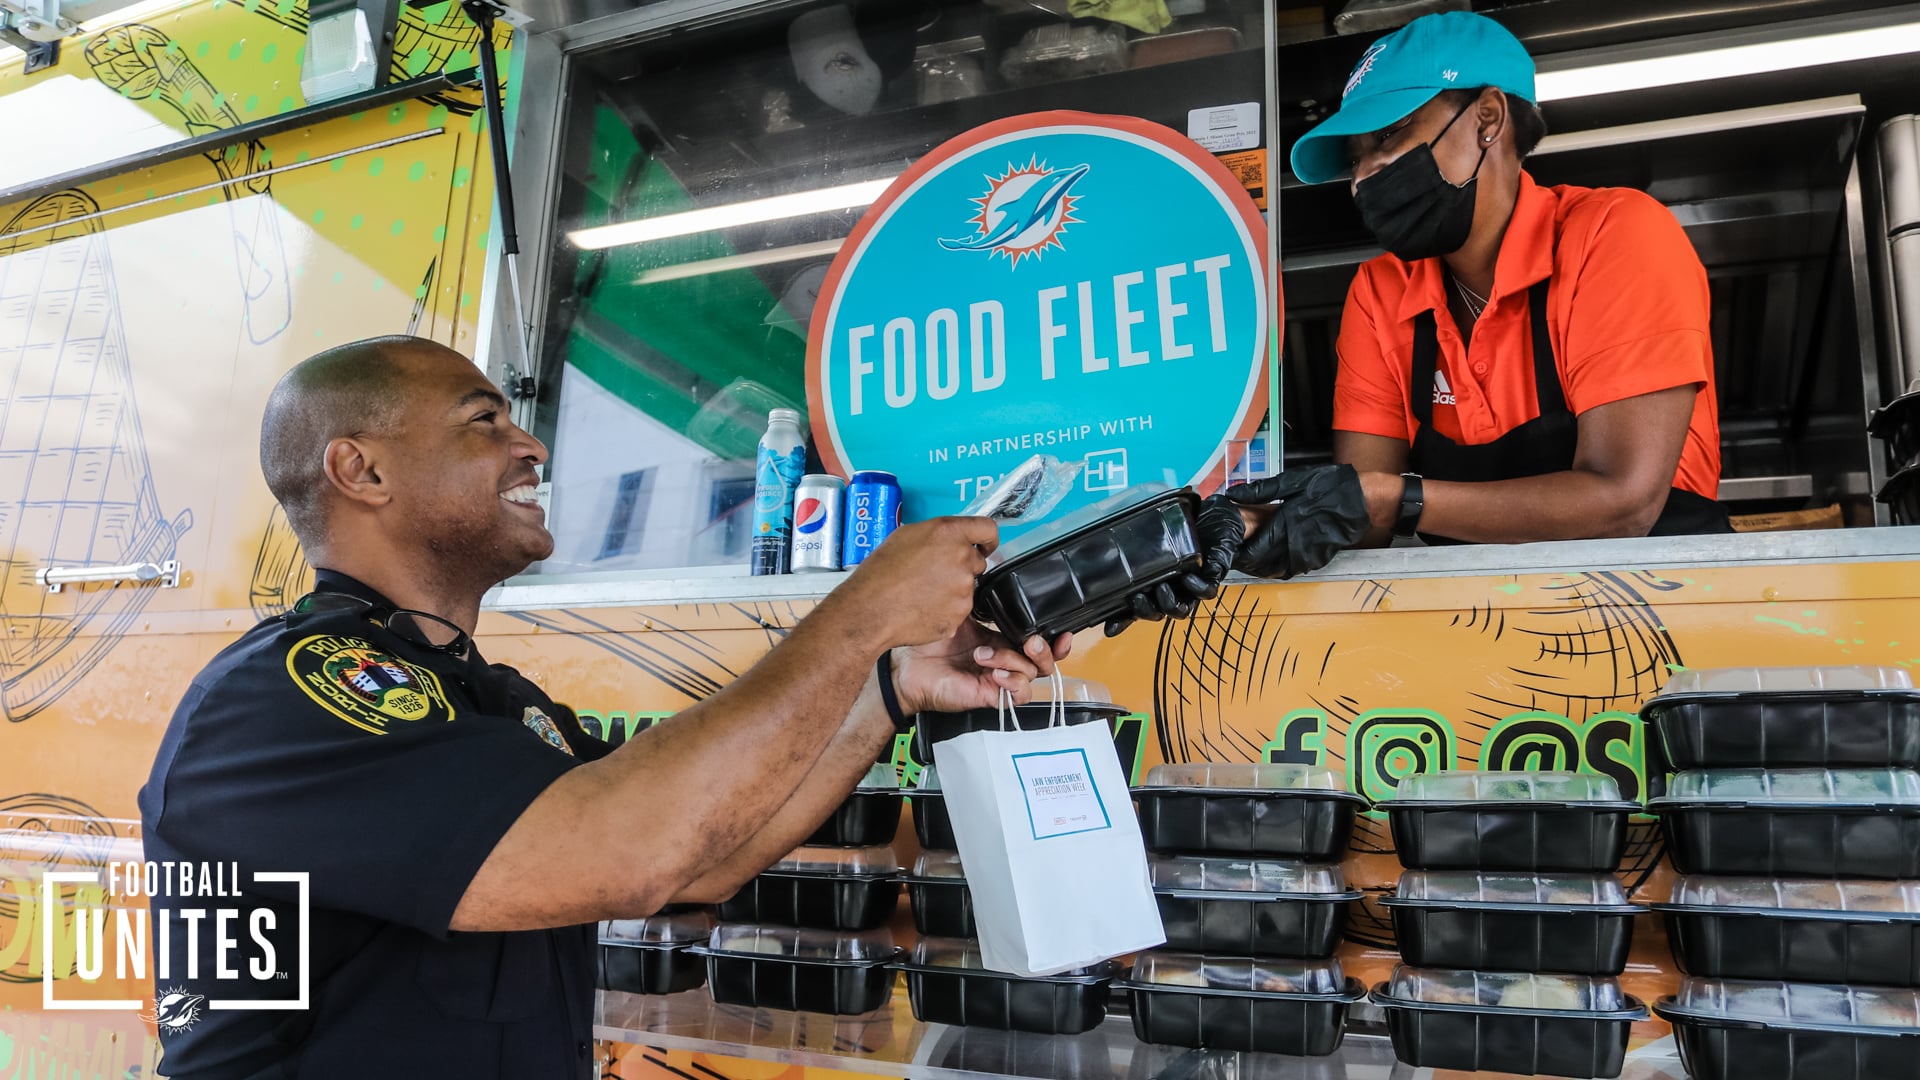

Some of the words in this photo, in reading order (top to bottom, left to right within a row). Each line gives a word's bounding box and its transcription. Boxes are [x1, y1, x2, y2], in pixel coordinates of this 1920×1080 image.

[849, 300, 1006, 416] FOOD
[1038, 253, 1231, 381] FLEET
[1433, 391, 1456, 405] das
[929, 449, 948, 464] IN
[957, 425, 1091, 460] PARTNERSHIP
[1099, 415, 1153, 437] WITH
[855, 492, 872, 548] pepsi
[795, 540, 823, 552] pepsi
[306, 671, 389, 727] NORTH
[388, 692, 419, 708] SINCE
[398, 702, 424, 715] 1926
[1031, 776, 1044, 787] LAW
[1044, 773, 1082, 785] ENFORCEMENT
[1034, 784, 1071, 796] APPRECIATION
[1071, 782, 1086, 792] WEEK
